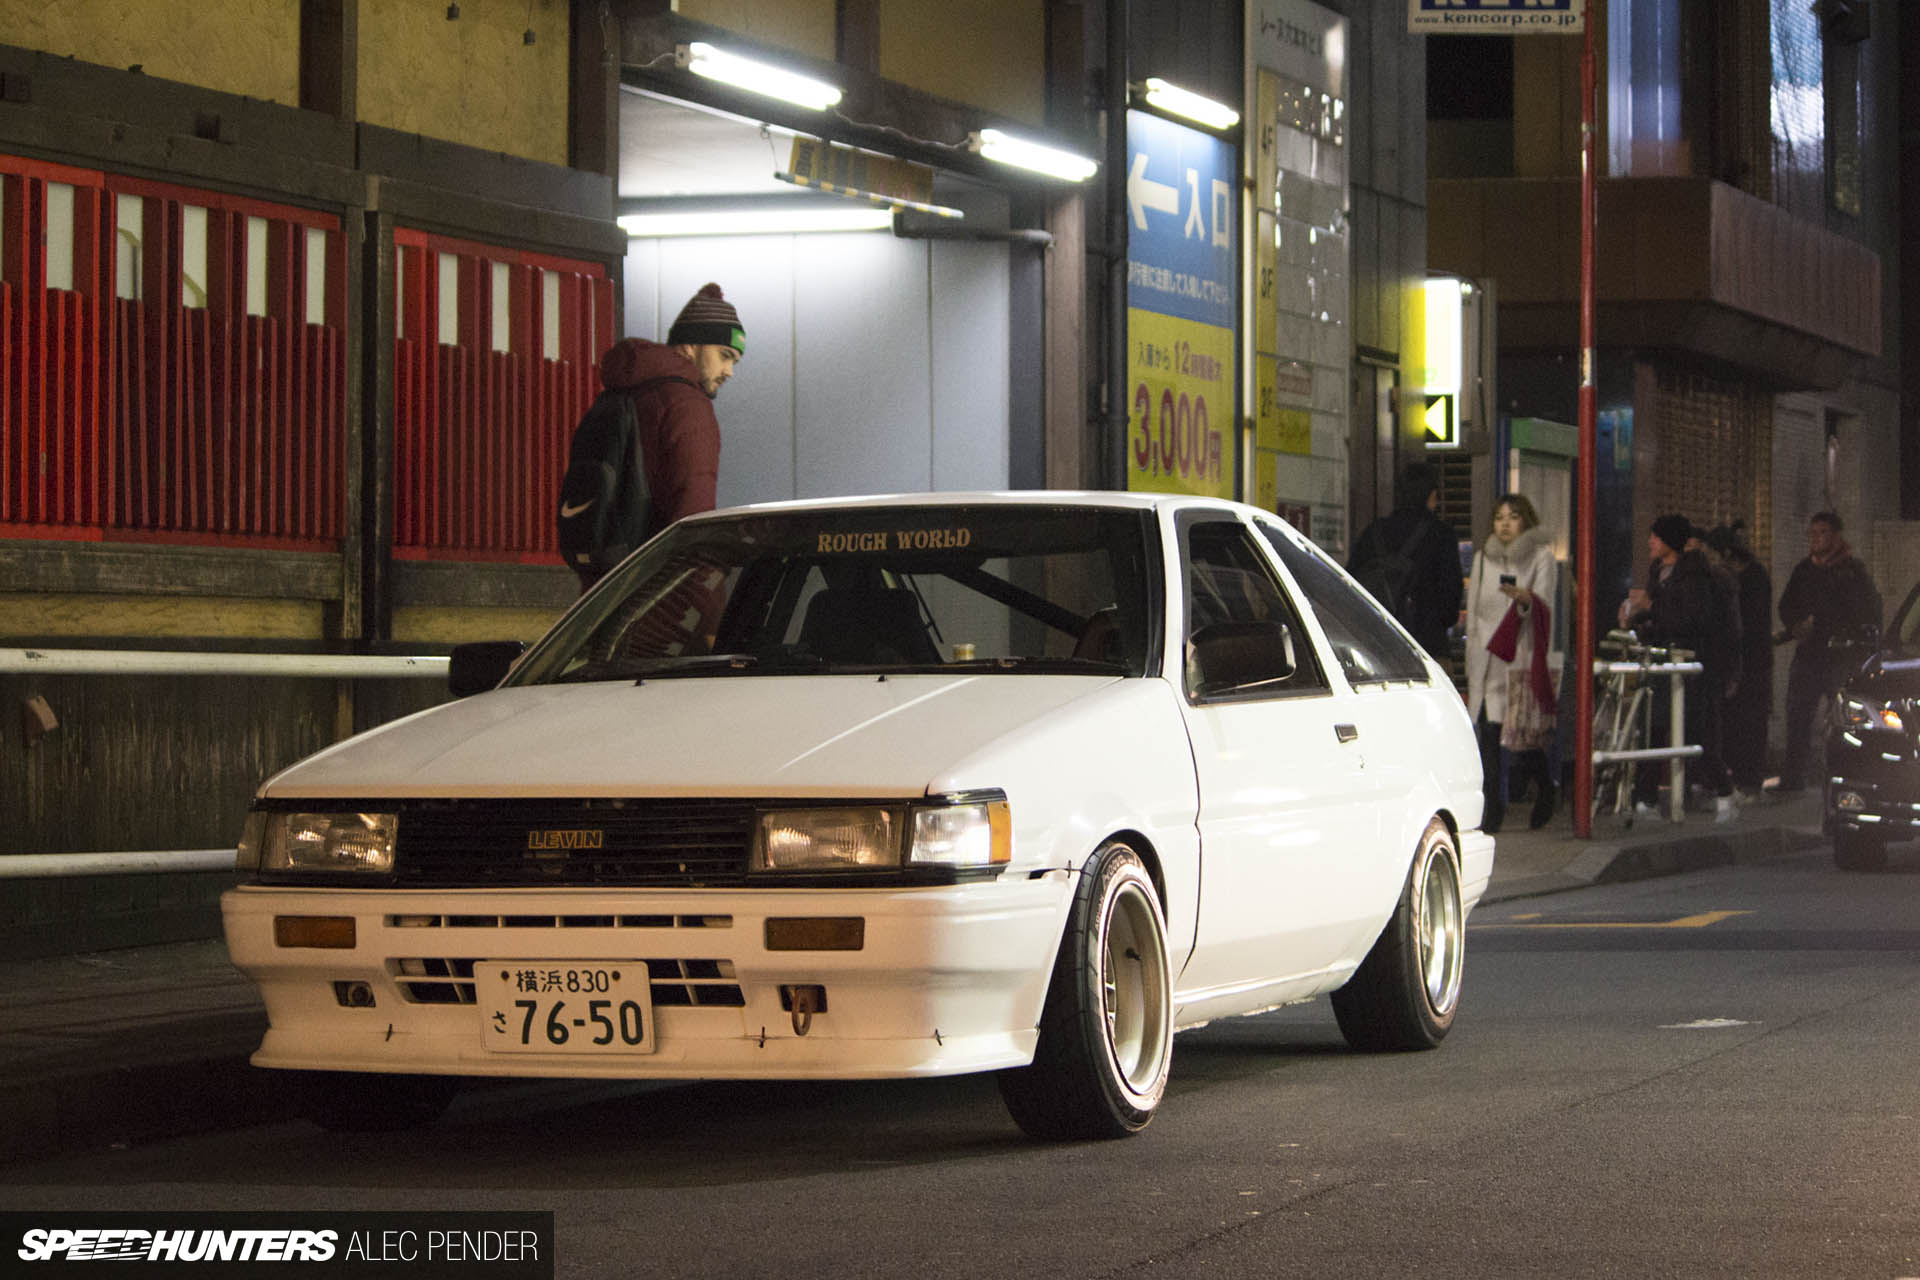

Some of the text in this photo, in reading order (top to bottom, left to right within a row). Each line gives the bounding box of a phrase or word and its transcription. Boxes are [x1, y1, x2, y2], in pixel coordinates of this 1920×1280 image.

[1415, 12, 1576, 26] www.kencorp.co.jp
[1184, 167, 1230, 250] 入口
[817, 527, 971, 553] ROUGH WORLD
[528, 830, 603, 850] LEVIN
[492, 1000, 644, 1045] さ 76-50
